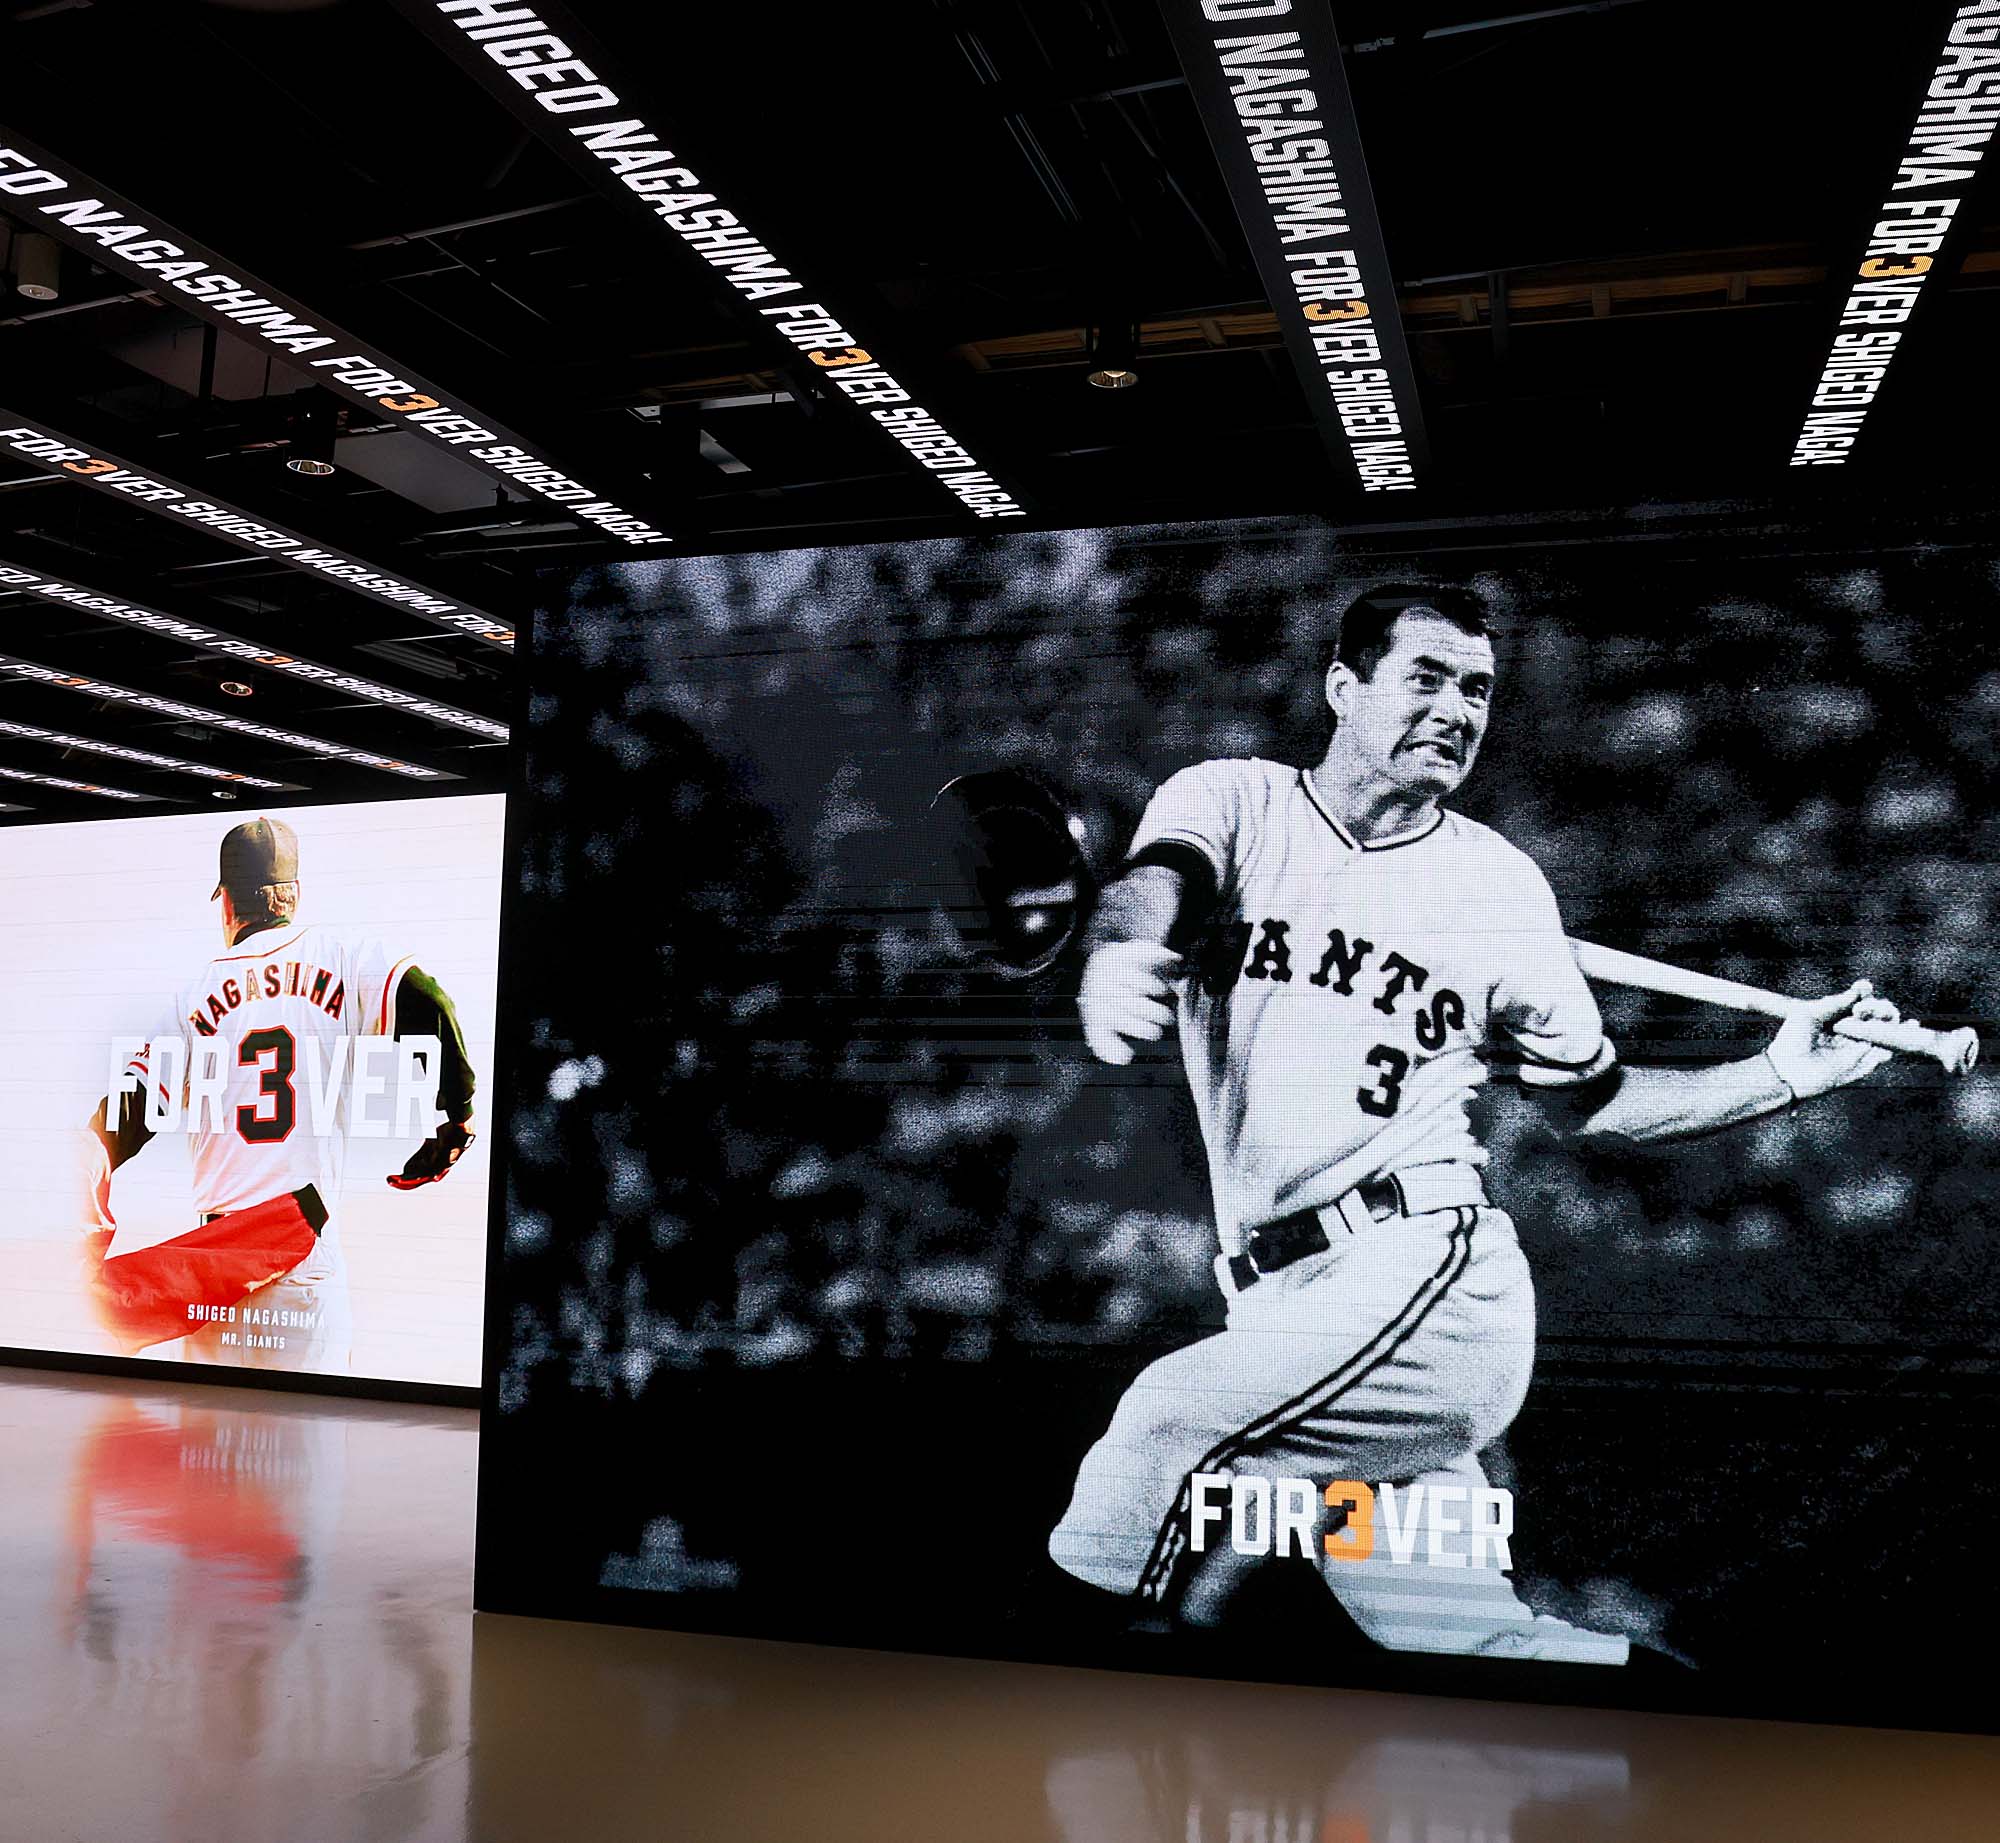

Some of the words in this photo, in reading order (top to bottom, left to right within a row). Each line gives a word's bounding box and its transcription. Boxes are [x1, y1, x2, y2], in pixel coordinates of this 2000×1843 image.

[1213, 31, 1350, 244] NAGASHIMA
[436, 0, 619, 114] HIGEO
[569, 119, 803, 300] NAGASHIMA
[759, 304, 911, 405] FOR3VER
[870, 407, 976, 469] SHIGEO
[1839, 199, 1961, 326] FOR3VER
[38, 199, 336, 354] NAGASHIMA
[309, 355, 498, 445] FOR3VER
[469, 445, 596, 501] SHIGEO
[1285, 250, 1381, 364] FOR3VER
[1326, 368, 1402, 437] SHIGEO
[1812, 331, 1902, 406] SHIGEO
[0, 428, 186, 501] FOR3VER
[166, 501, 302, 549] SHIGEO
[281, 549, 458, 614] NAGASHIMA
[0, 664, 138, 698] FOR3VER
[27, 583, 216, 641] NAGASHIMA
[205, 640, 338, 679] FOR3VER
[323, 677, 418, 704] SHIGEO
[189, 961, 345, 1036] NAGASHIMA
[1245, 917, 1465, 1051] ANTS
[1356, 1043, 1410, 1118] 3
[187, 1303, 236, 1323] SHIGEO
[242, 1307, 326, 1329] NAGASHIMA
[221, 1332, 241, 1346] MR.
[246, 1334, 286, 1349] GIANTS
[1190, 1472, 1514, 1571] FOR3VER
